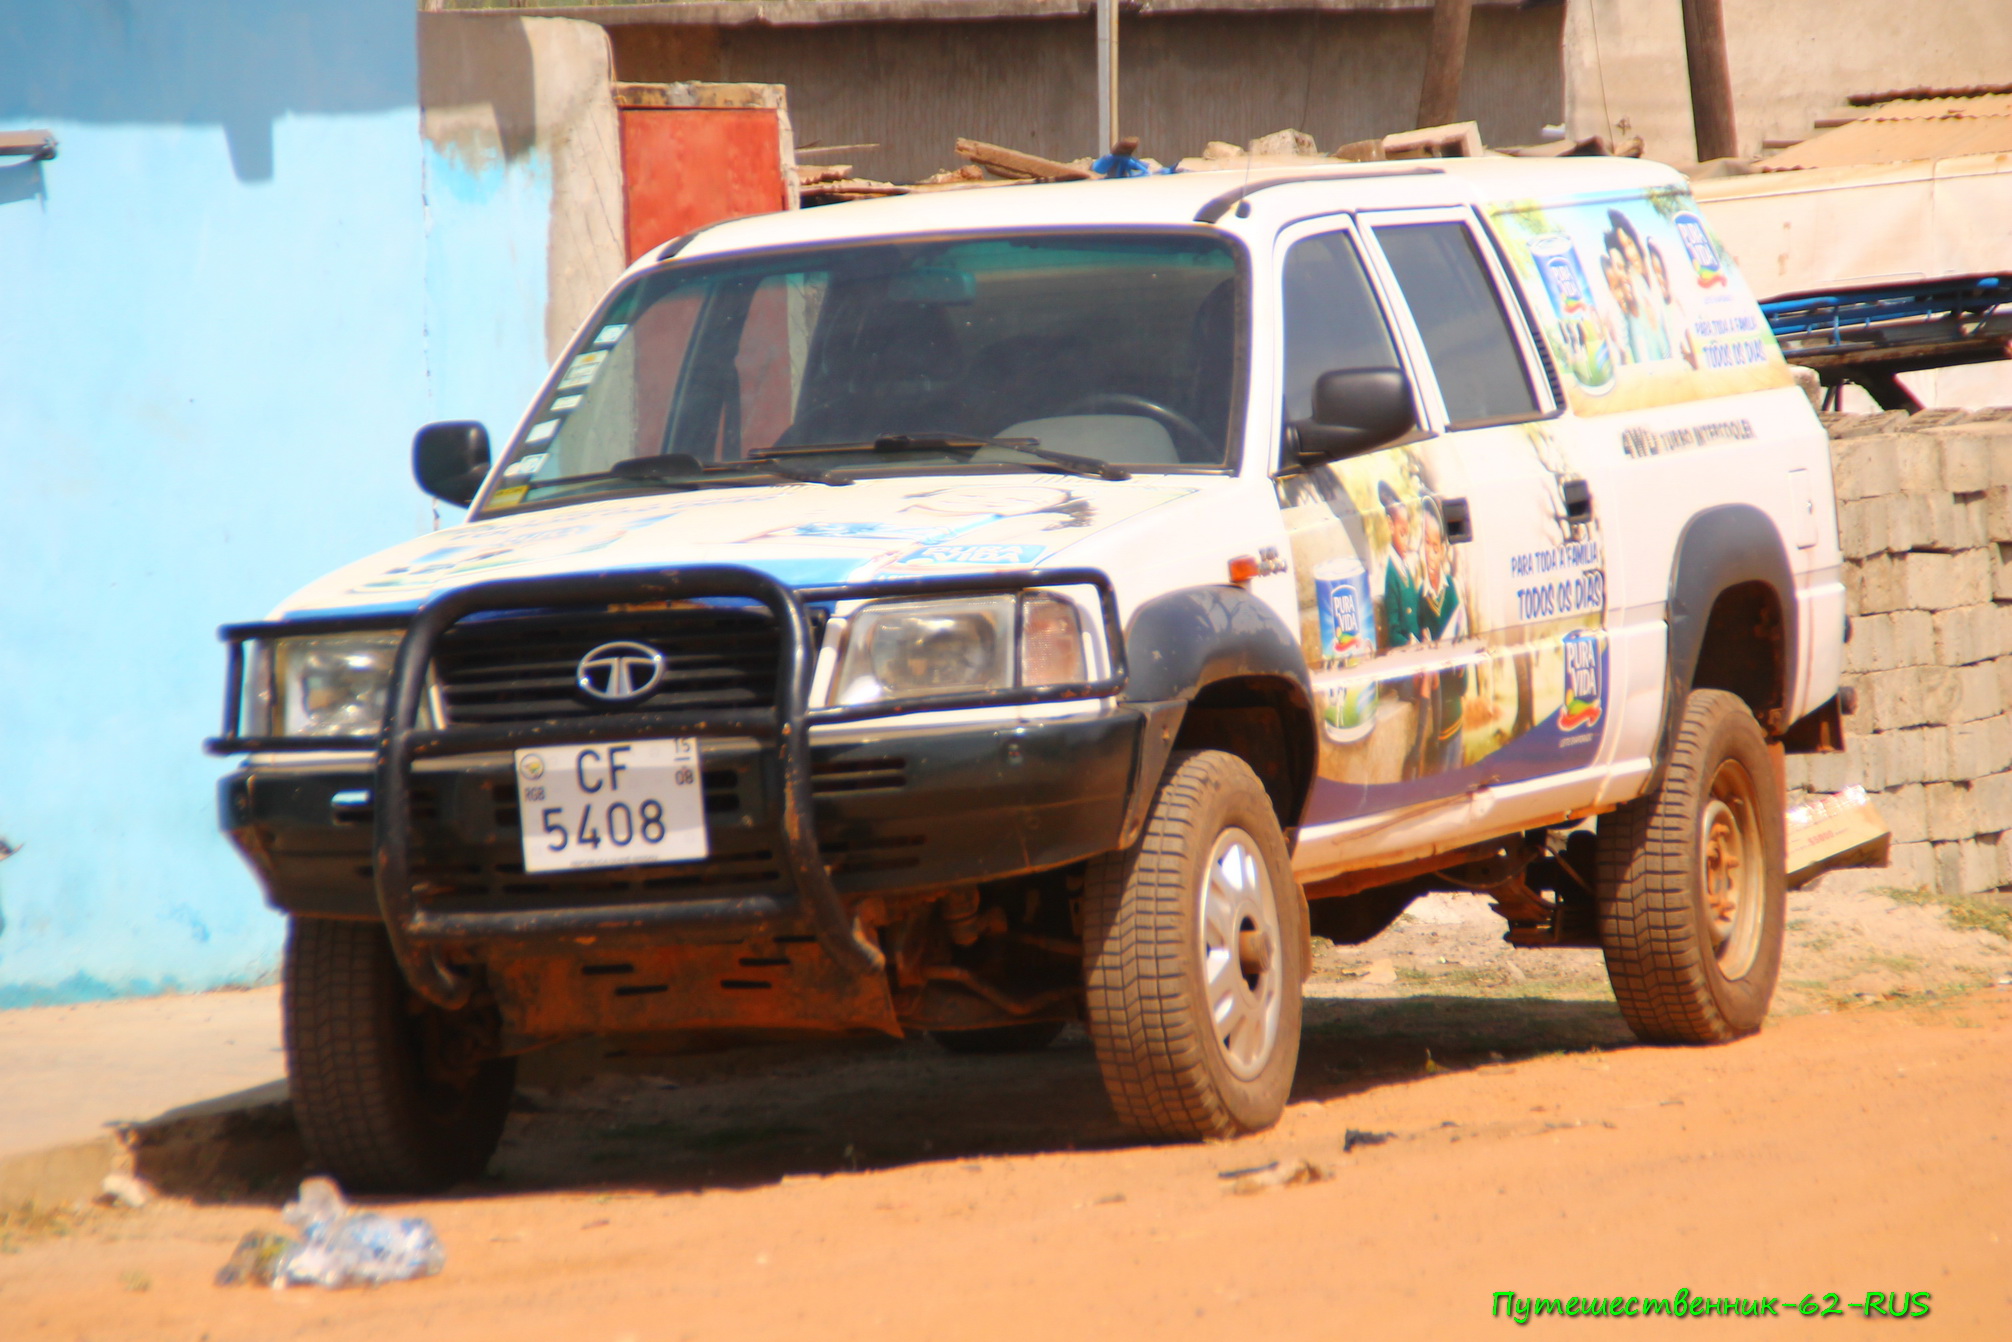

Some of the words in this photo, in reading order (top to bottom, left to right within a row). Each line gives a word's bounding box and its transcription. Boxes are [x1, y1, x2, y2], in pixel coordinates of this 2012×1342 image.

[1702, 343, 1734, 369] TODOS
[1731, 342, 1746, 366] OS
[1510, 552, 1534, 578] PARA
[1534, 548, 1558, 574] TODA
[1558, 545, 1566, 569] A
[1334, 594, 1356, 616] PURA
[1517, 582, 1555, 620] TODOS
[1556, 579, 1573, 613] OS
[1575, 573, 1602, 609] DIAS
[1338, 612, 1358, 632] VIDA
[1565, 639, 1597, 672] PURA
[1571, 666, 1598, 697] VIDA
[575, 745, 632, 794] CF
[674, 768, 695, 786] 08
[523, 786, 546, 803] RGB
[541, 798, 667, 852] 5408
